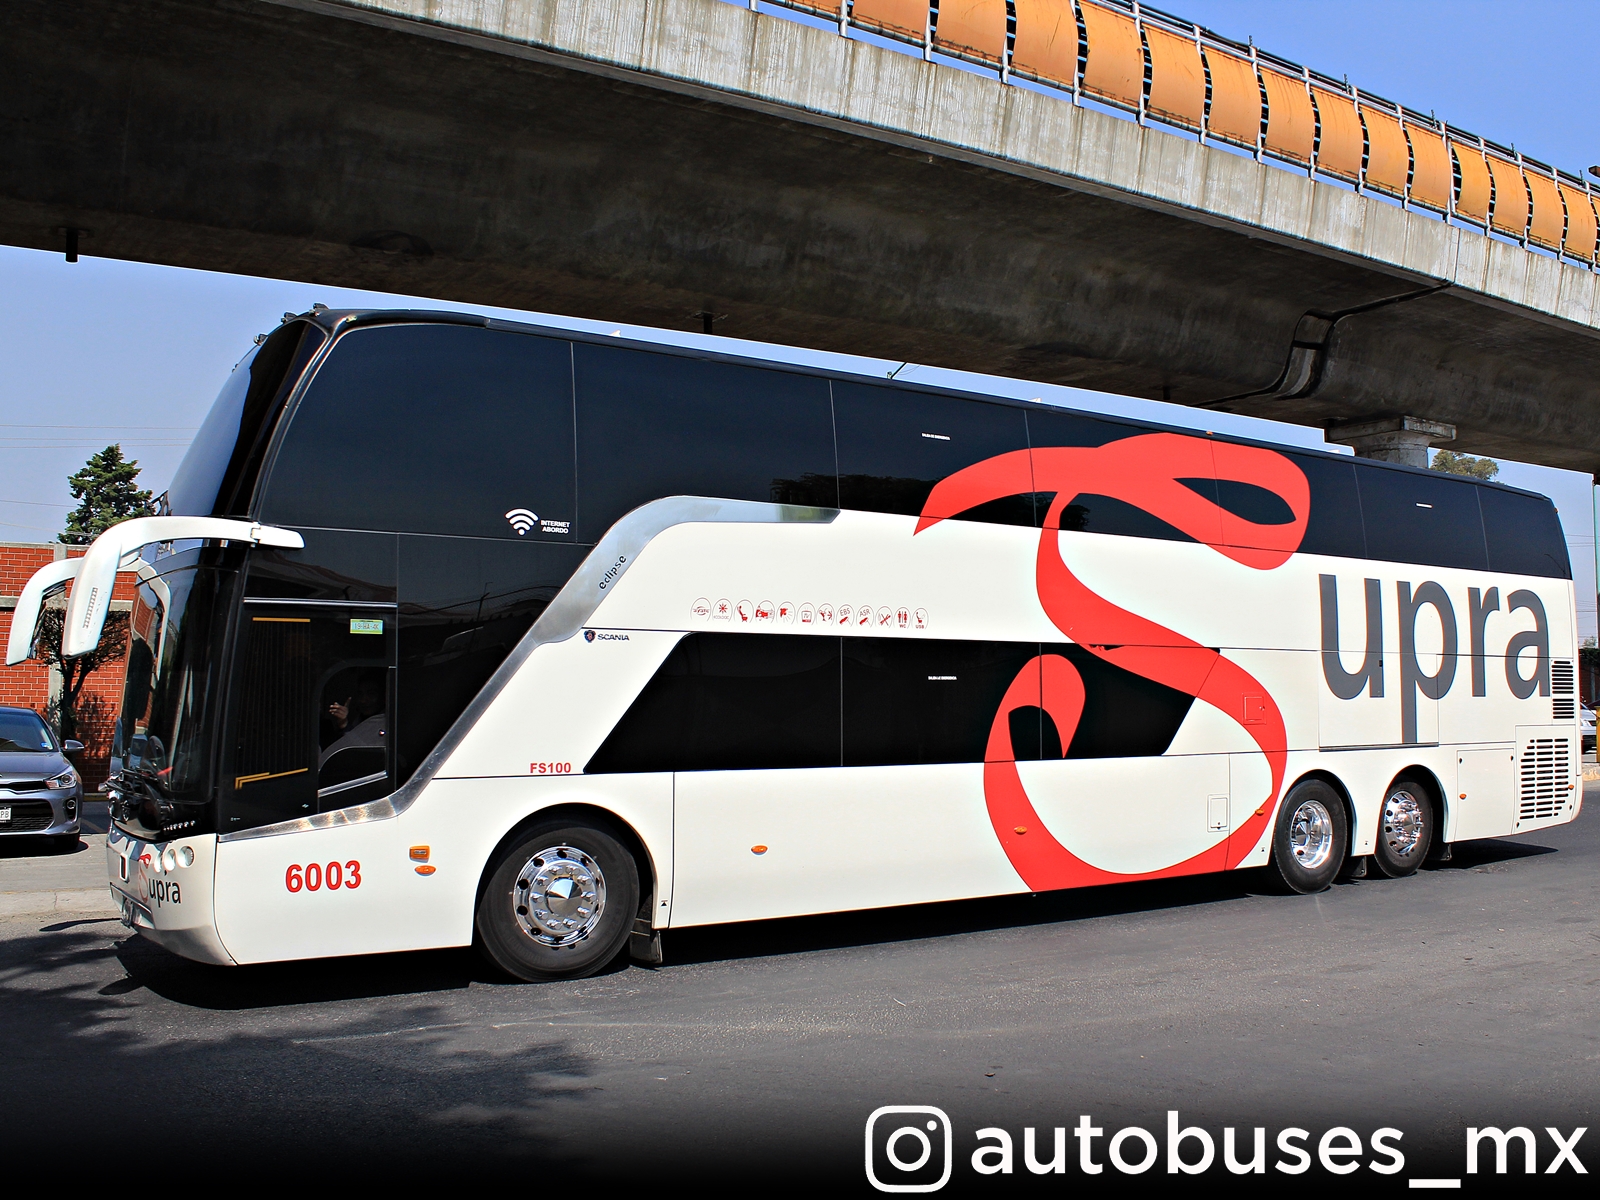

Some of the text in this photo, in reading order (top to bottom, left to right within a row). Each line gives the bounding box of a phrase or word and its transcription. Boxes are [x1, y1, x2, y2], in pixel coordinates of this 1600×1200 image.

[541, 519, 571, 527] INTERNET
[542, 526, 569, 534] ABORDO
[599, 555, 627, 590] eclipse
[840, 608, 851, 616] EBS
[860, 608, 871, 617] ASR
[597, 633, 630, 641] SCANIA
[530, 762, 572, 774] FS100
[138, 854, 182, 908] Supra
[285, 860, 362, 893] 6003
